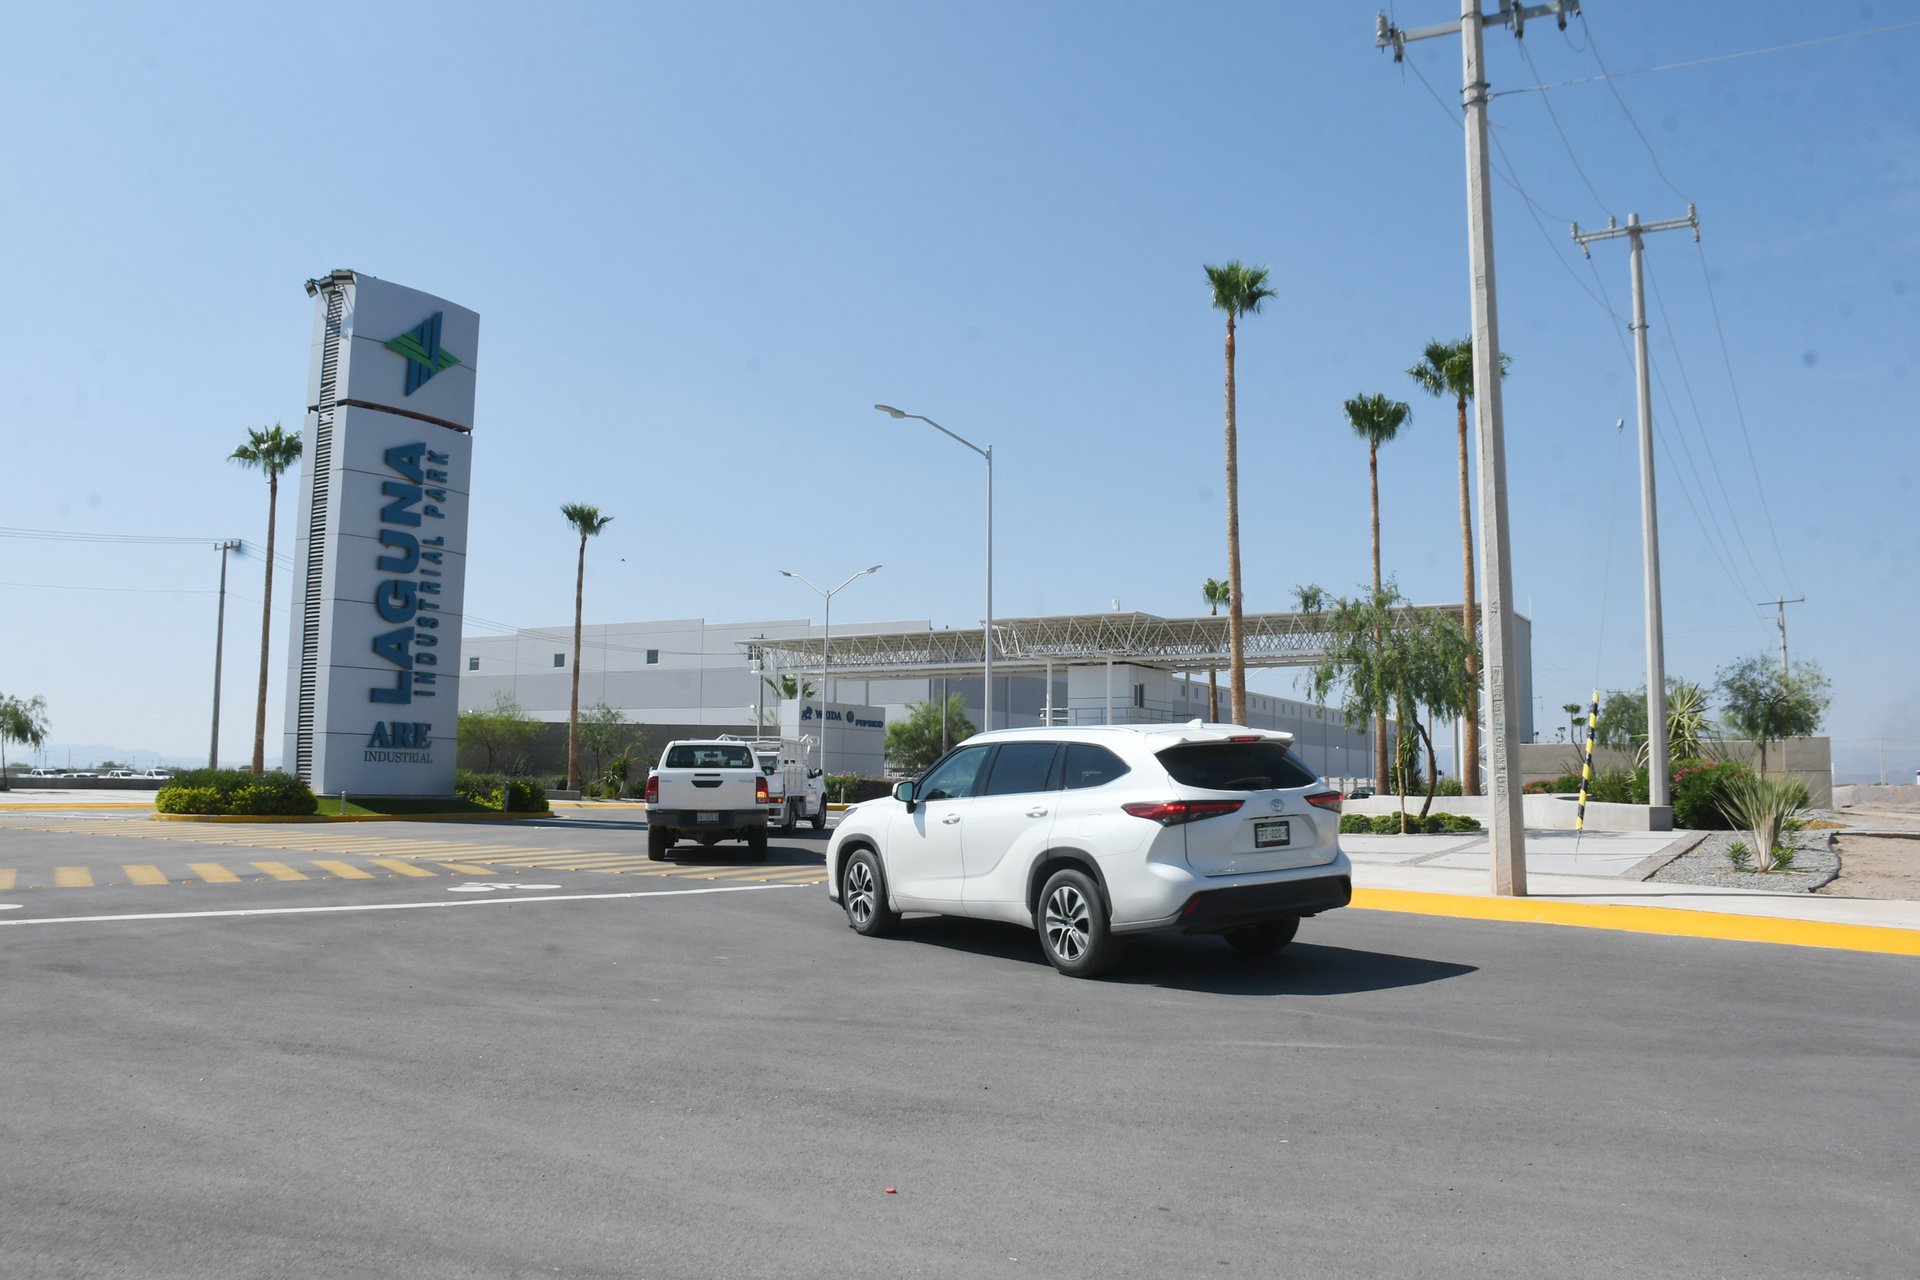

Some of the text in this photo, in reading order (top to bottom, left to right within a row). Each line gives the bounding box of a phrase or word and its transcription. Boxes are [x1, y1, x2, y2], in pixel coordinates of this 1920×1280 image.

[370, 442, 426, 704] LAGUNA
[414, 450, 449, 697] INDUSTRIAL PARK
[367, 721, 432, 750] ARE
[855, 719, 883, 728] PEPSICO
[363, 751, 433, 764] INDUSTRIAL
